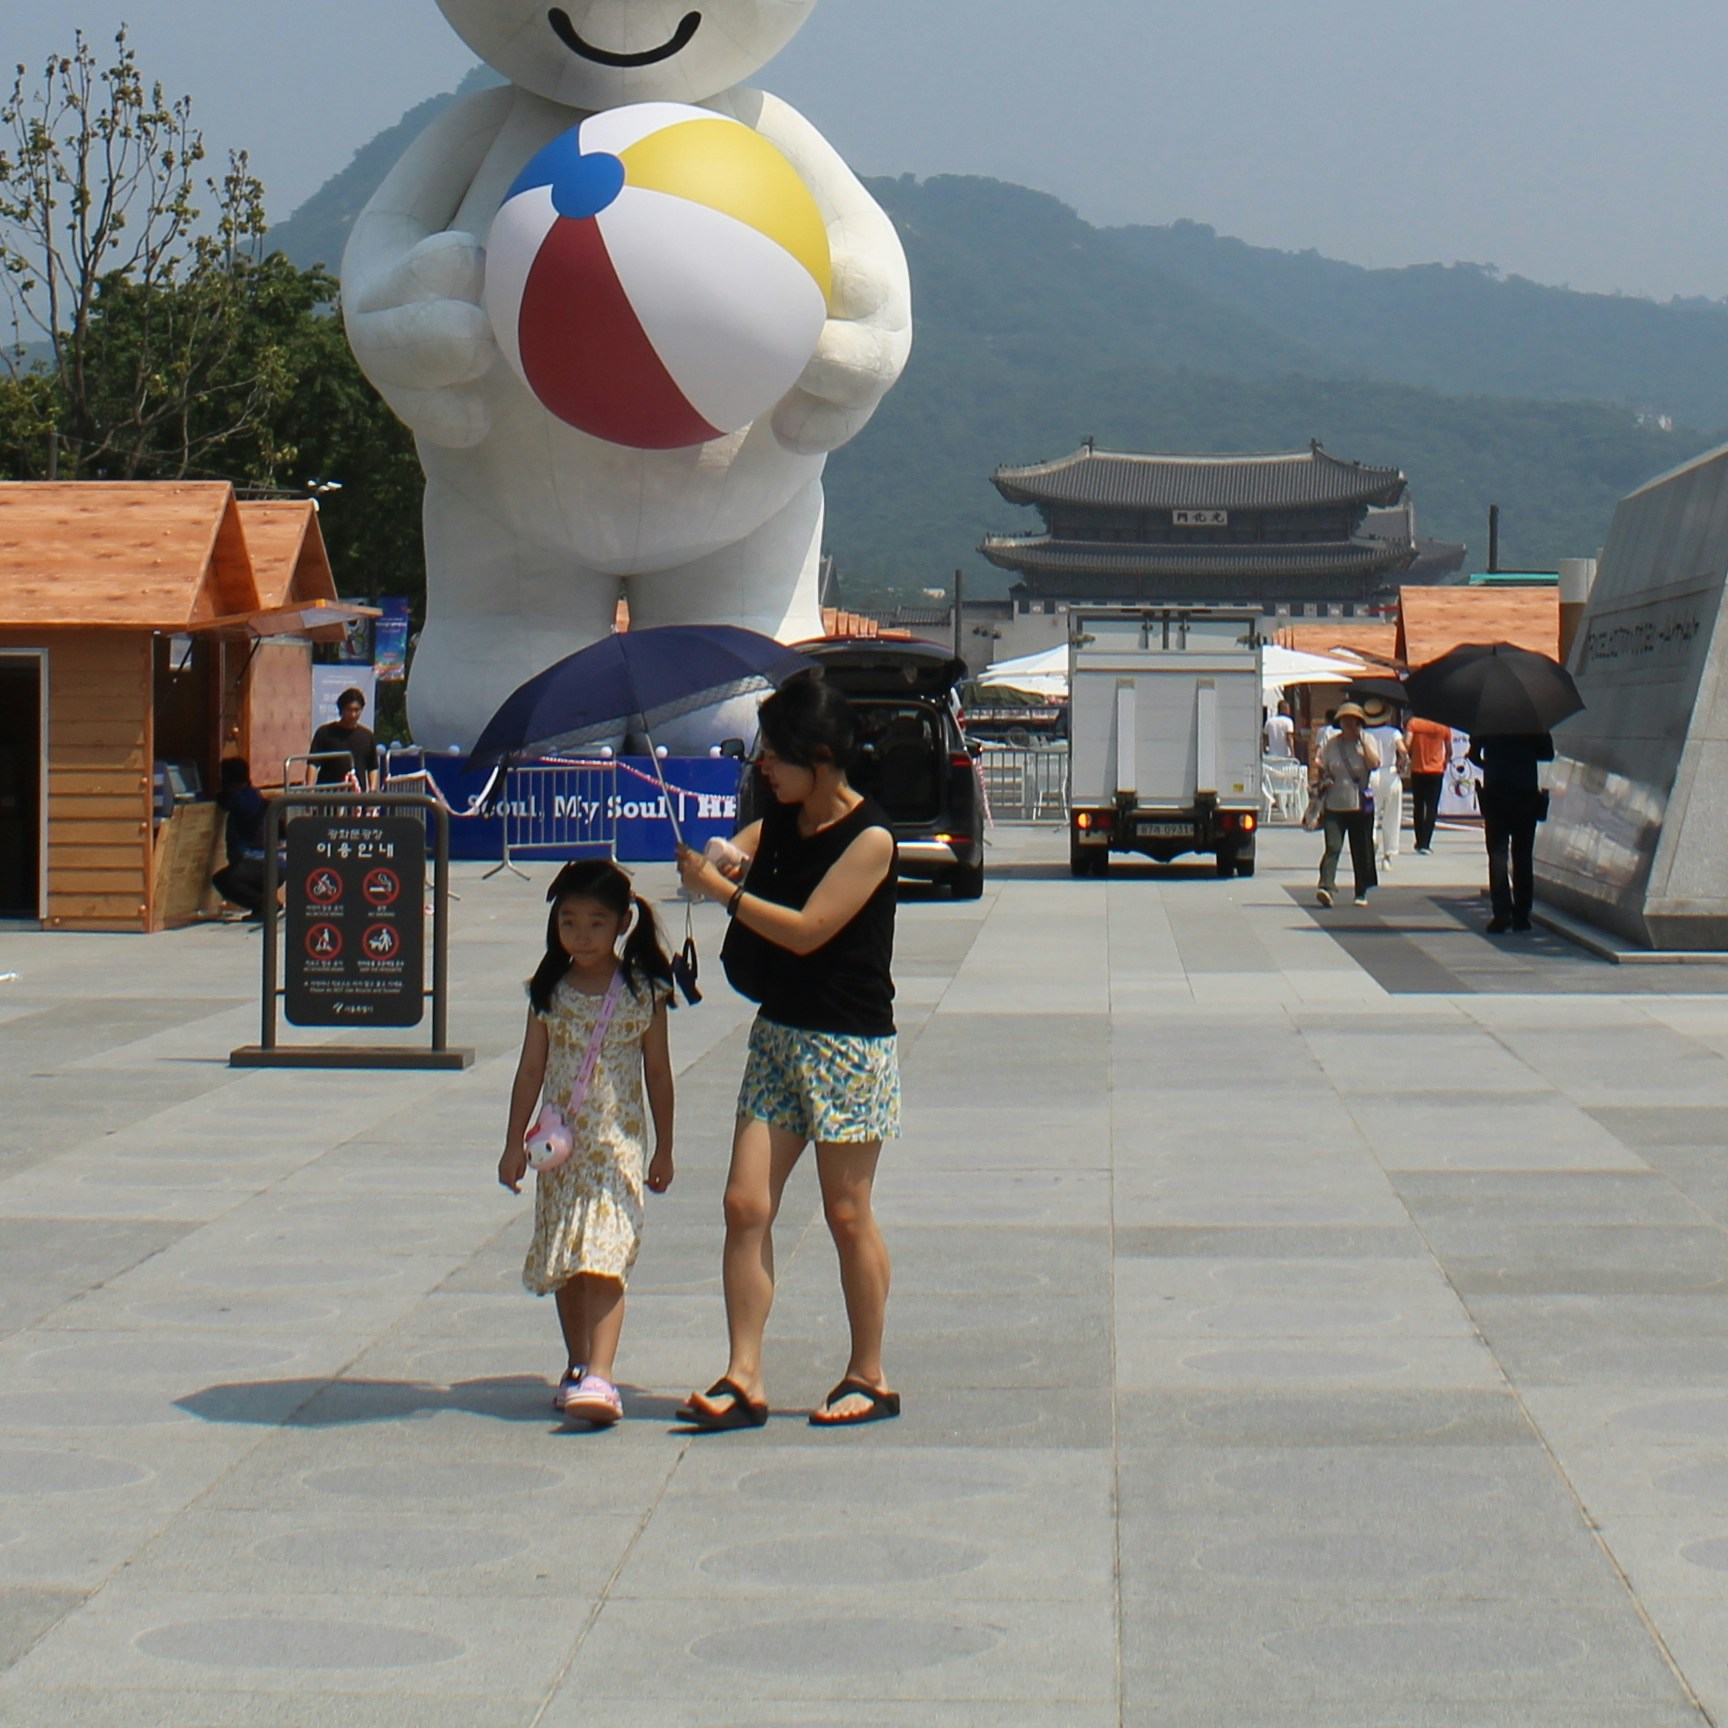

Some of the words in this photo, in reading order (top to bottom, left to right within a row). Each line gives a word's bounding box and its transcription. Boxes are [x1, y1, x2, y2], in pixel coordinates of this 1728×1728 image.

[554, 795, 599, 825] My
[608, 795, 668, 819] Soul
[327, 828, 384, 840] 광화문광장
[316, 842, 394, 858] 이용안내
